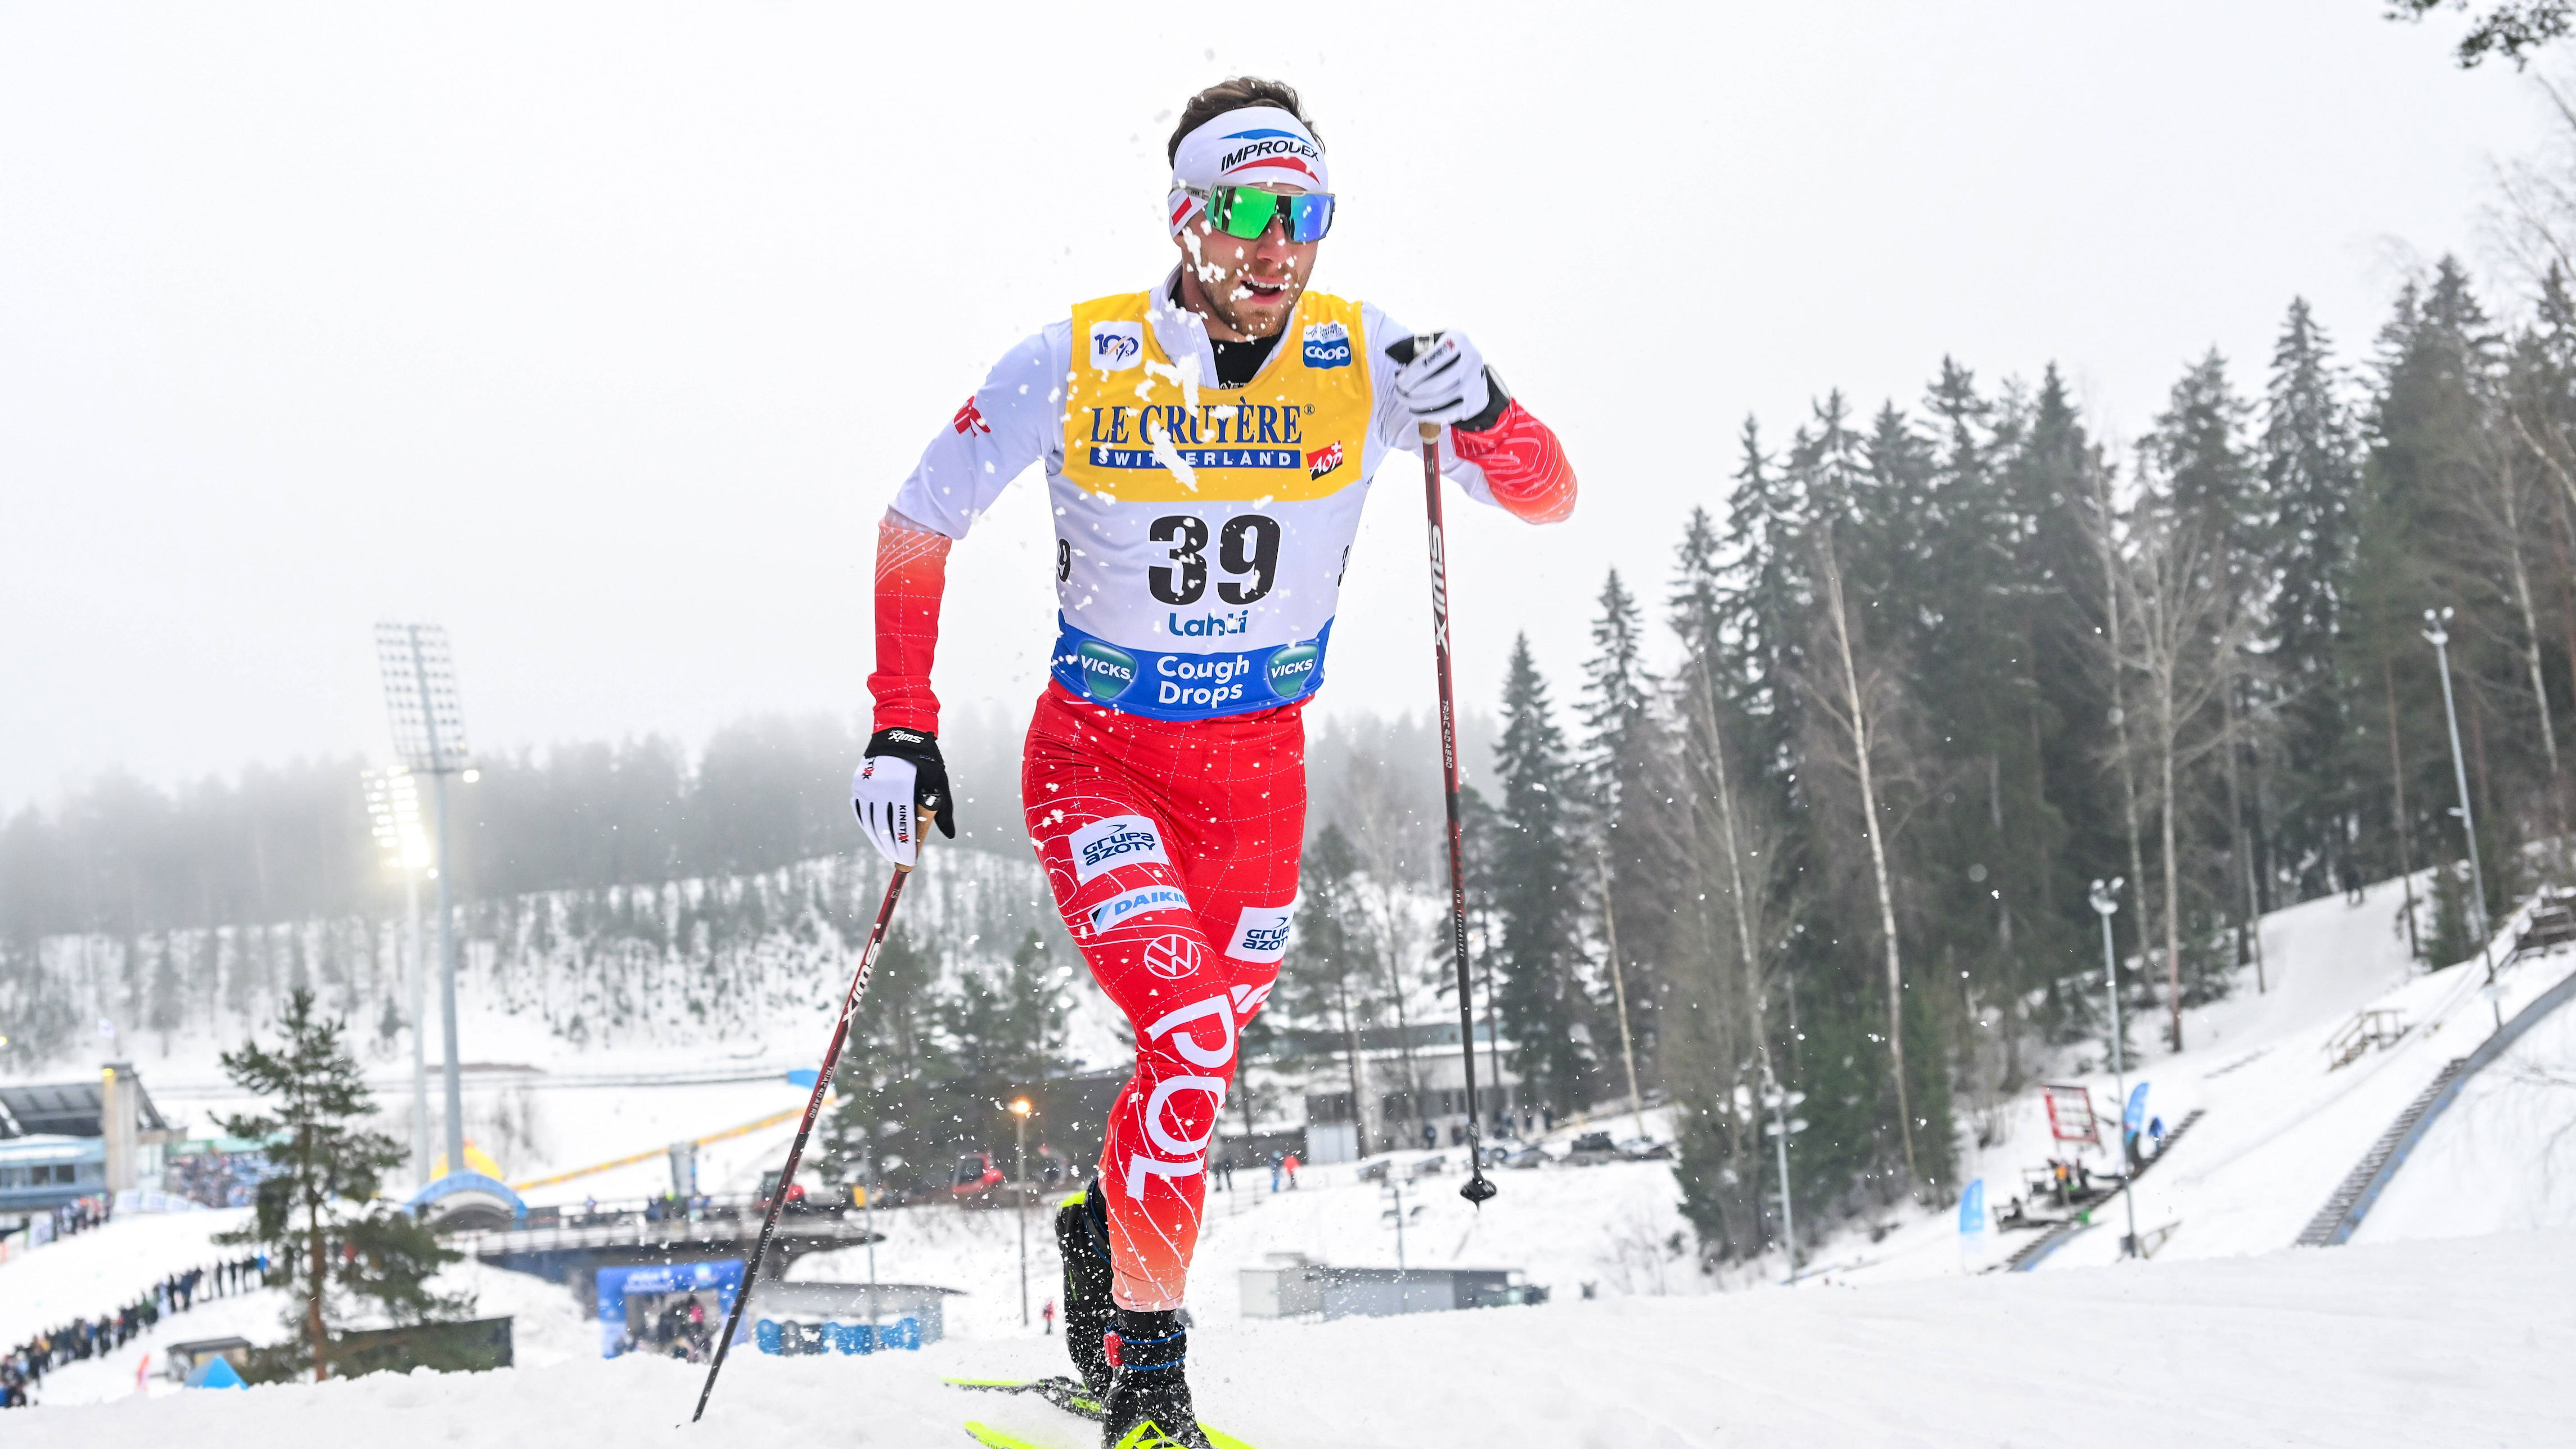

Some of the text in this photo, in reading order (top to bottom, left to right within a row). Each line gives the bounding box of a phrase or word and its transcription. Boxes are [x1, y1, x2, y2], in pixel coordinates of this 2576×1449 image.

[1305, 345, 1349, 361] coop
[1090, 406, 1131, 444] LE
[1098, 451, 1291, 466] SWITERLAND
[1310, 452, 1343, 475] AOP
[1148, 514, 1281, 605] 39
[1081, 655, 1132, 680] VICKS
[1156, 654, 1250, 685] Cough
[1271, 658, 1313, 679] VICKS
[1158, 681, 1242, 709] Drops
[1114, 892, 1188, 916] DAIKIN
[1127, 994, 1235, 1201] POL
